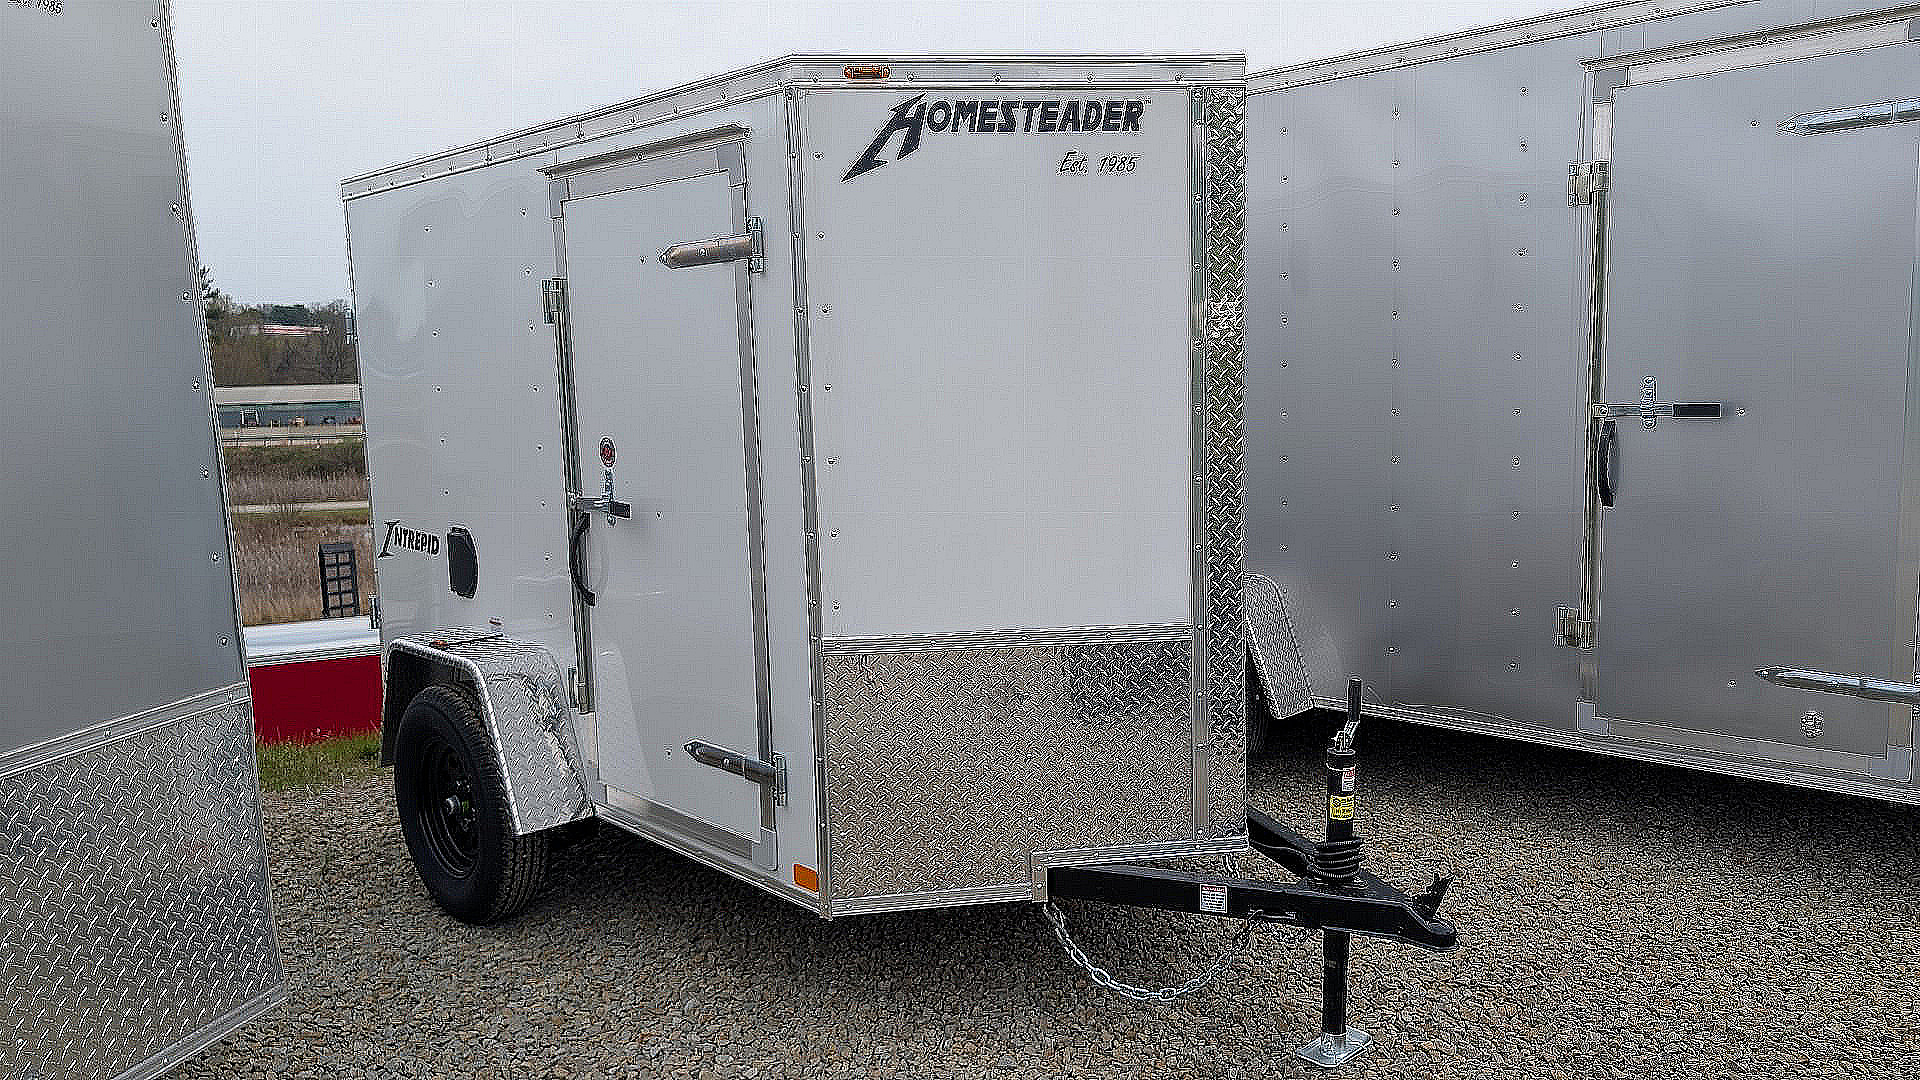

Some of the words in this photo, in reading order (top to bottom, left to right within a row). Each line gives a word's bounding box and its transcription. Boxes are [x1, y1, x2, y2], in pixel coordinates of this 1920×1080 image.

[841, 92, 1145, 182] HOMESTEADER
[1099, 155, 1139, 172] 1985
[378, 521, 440, 557] INTREPID
